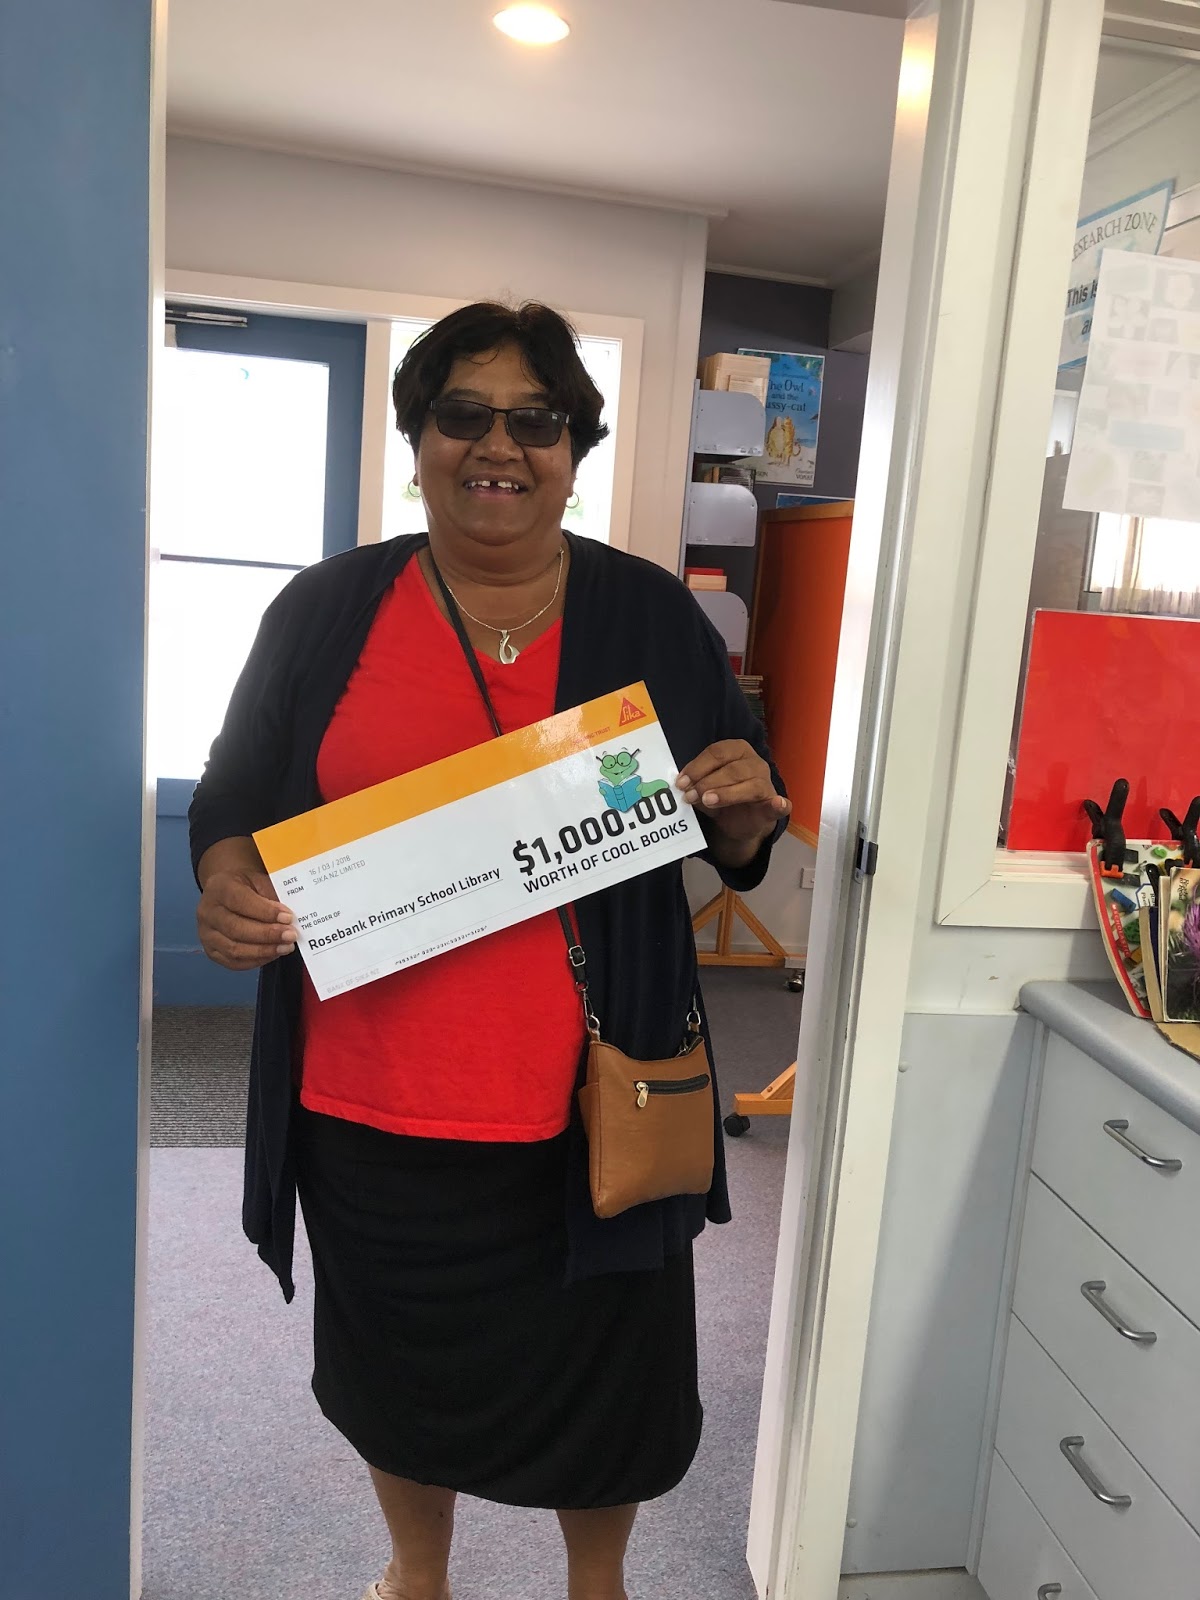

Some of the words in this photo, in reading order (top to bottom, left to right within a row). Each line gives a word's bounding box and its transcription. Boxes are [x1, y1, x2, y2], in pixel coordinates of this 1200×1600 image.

[1124, 212, 1158, 234] ZONE
[1067, 284, 1088, 308] This
[785, 379, 804, 392] Owl
[787, 393, 799, 401] the
[766, 402, 806, 413] ussy-cat
[621, 704, 640, 723] Sika
[512, 787, 678, 876] $1,000.00
[523, 862, 579, 893] WORTH
[581, 854, 599, 871] OF
[602, 840, 639, 862] COOL
[640, 819, 689, 848] BOOKS
[283, 876, 298, 887] DATE
[322, 863, 331, 871] 03
[336, 855, 351, 866] 2018
[287, 886, 304, 896] FROM
[313, 875, 329, 885] SIKA
[329, 871, 339, 879] NZ
[340, 860, 366, 875] LIMITED
[298, 915, 309, 923] PAY
[308, 920, 368, 951] Rosebank
[368, 901, 416, 926] Primary
[417, 883, 458, 907] School
[458, 868, 501, 891] Library
[314, 915, 333, 926] ORDER
[1113, 910, 1130, 957] SCHOLASTIC
